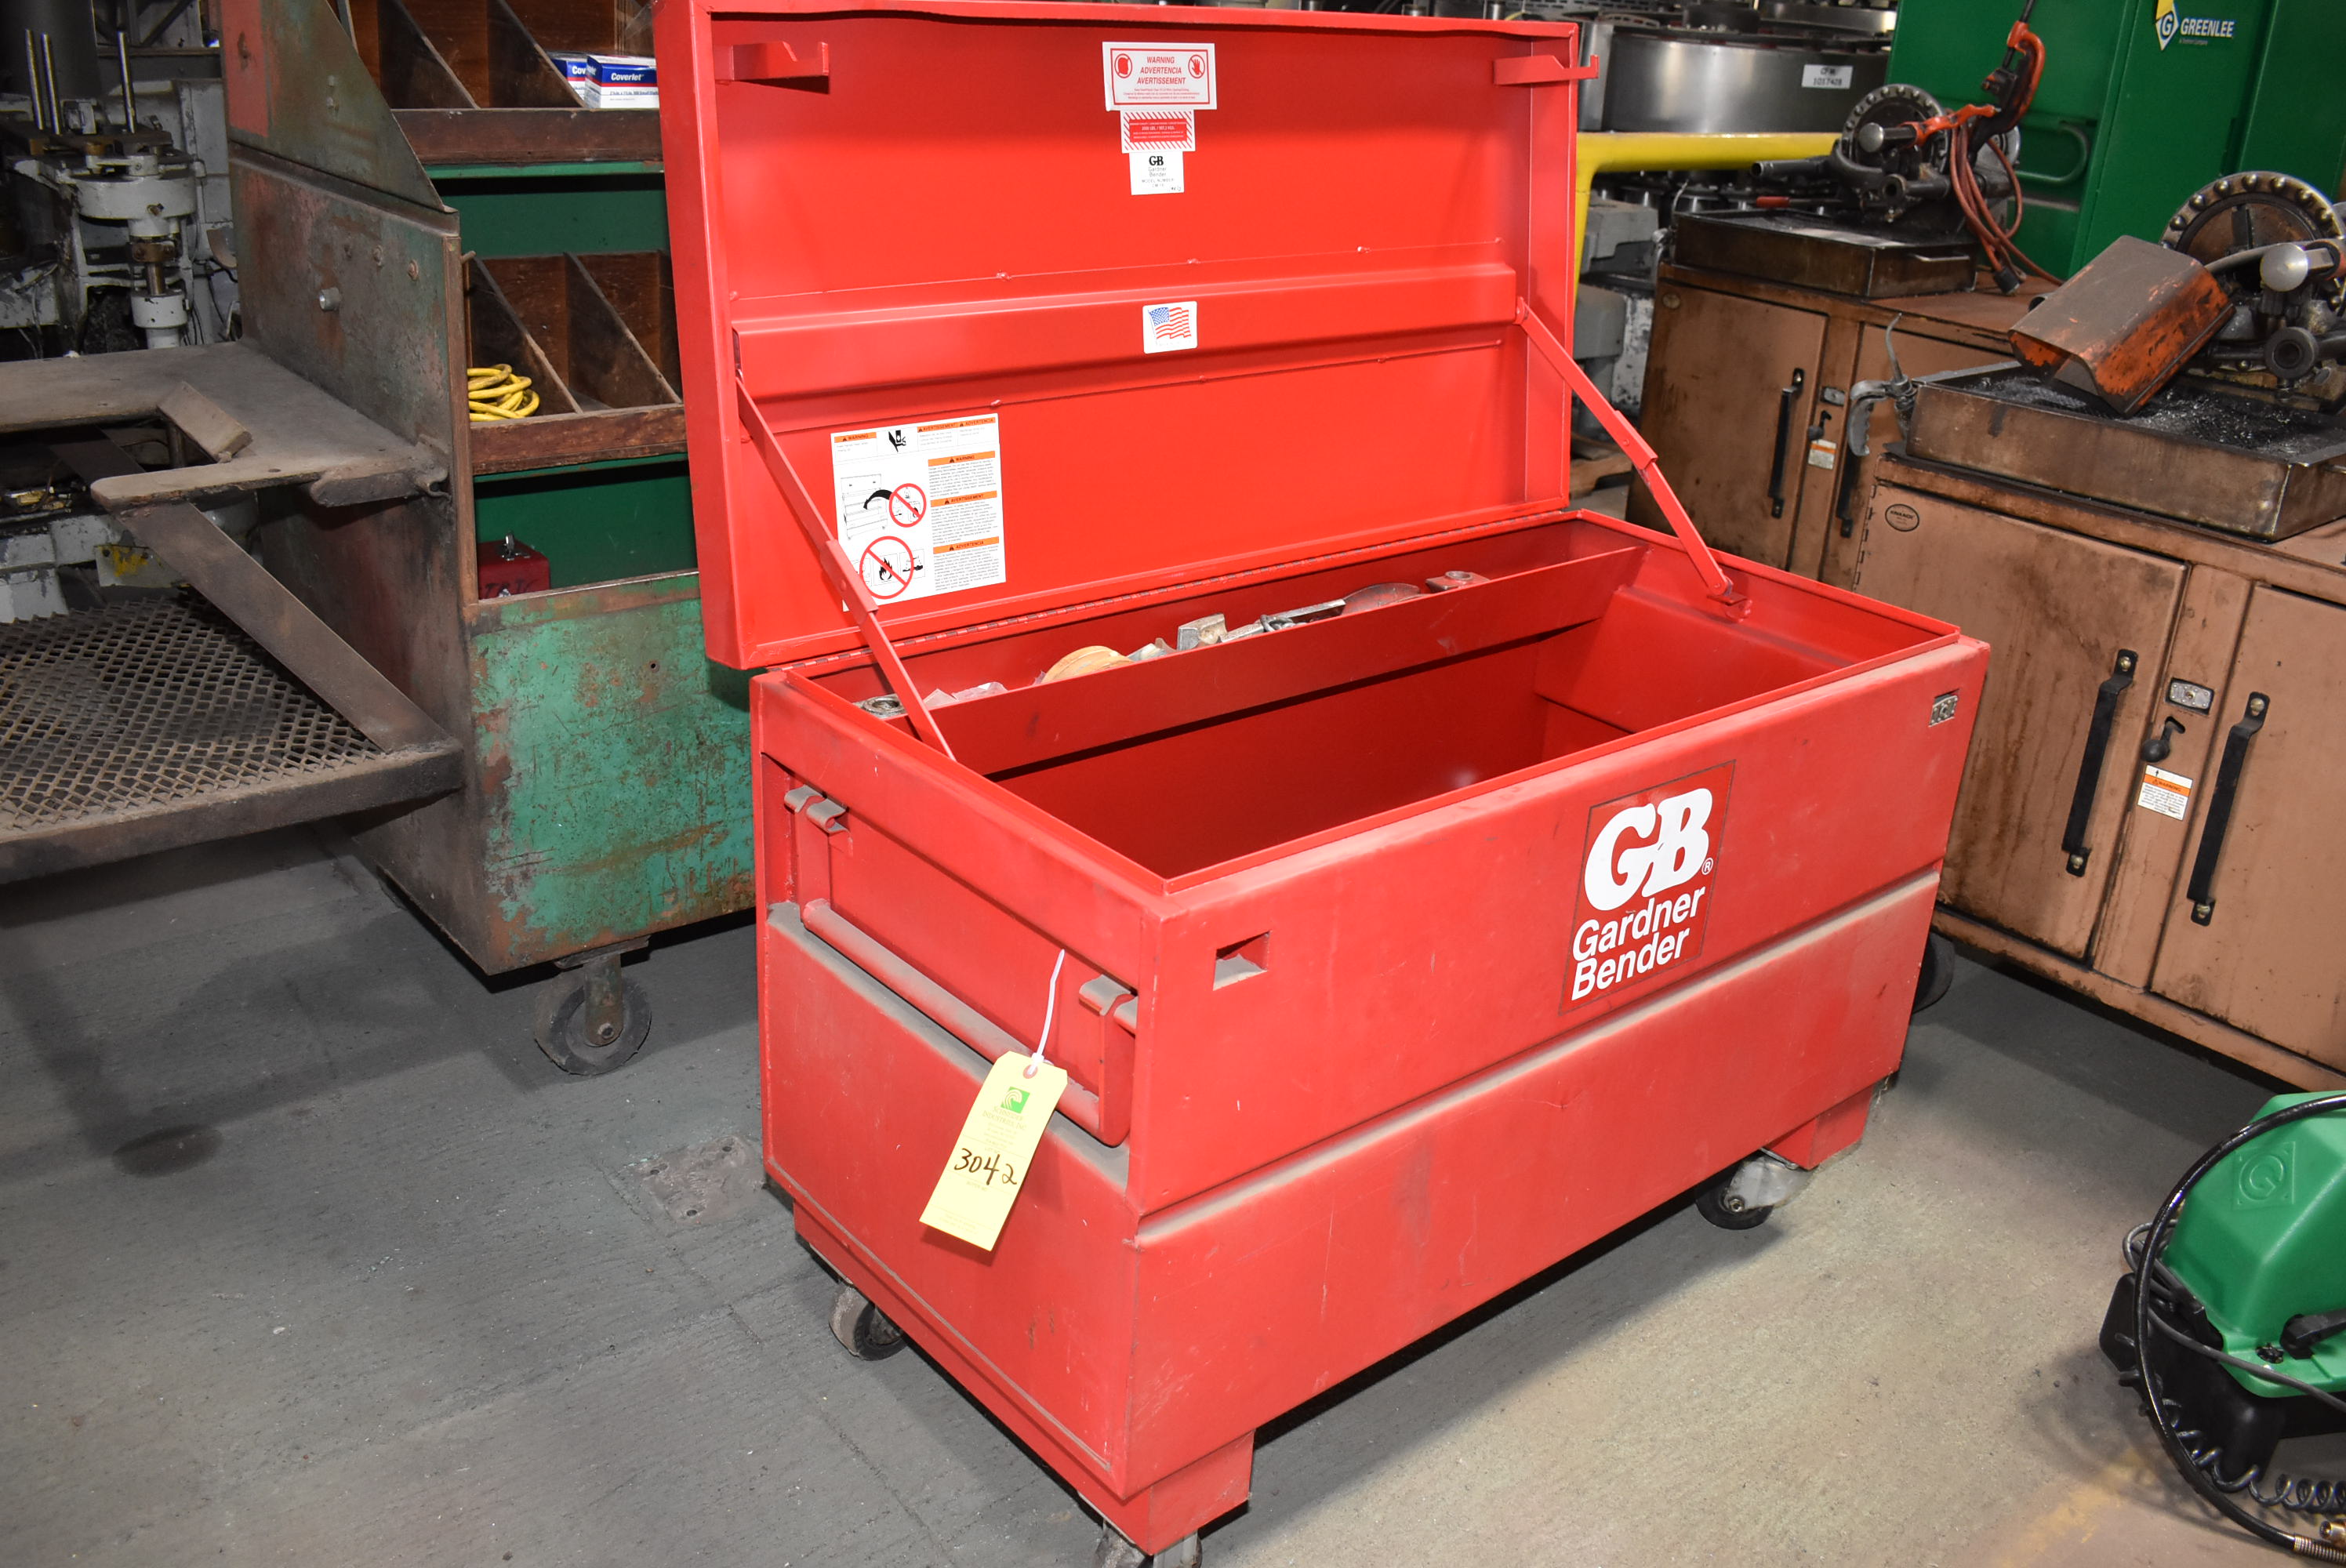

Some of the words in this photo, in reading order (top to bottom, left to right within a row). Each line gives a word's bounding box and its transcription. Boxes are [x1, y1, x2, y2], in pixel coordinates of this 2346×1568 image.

[2180, 16, 2235, 38] GREENLEE
[611, 72, 642, 82] Coverlet
[1136, 77, 1186, 85] AVERTISSEMENT
[1149, 155, 1164, 166] GB
[950, 493, 985, 503] AVERTISSEMENT
[956, 540, 985, 550] ADVERTENCIA
[2158, 780, 2182, 793] WARNING
[1584, 788, 1713, 912] GB
[1572, 886, 1706, 961] Gardner
[1571, 927, 1690, 1001] Bender
[953, 1147, 1018, 1186] 3042
